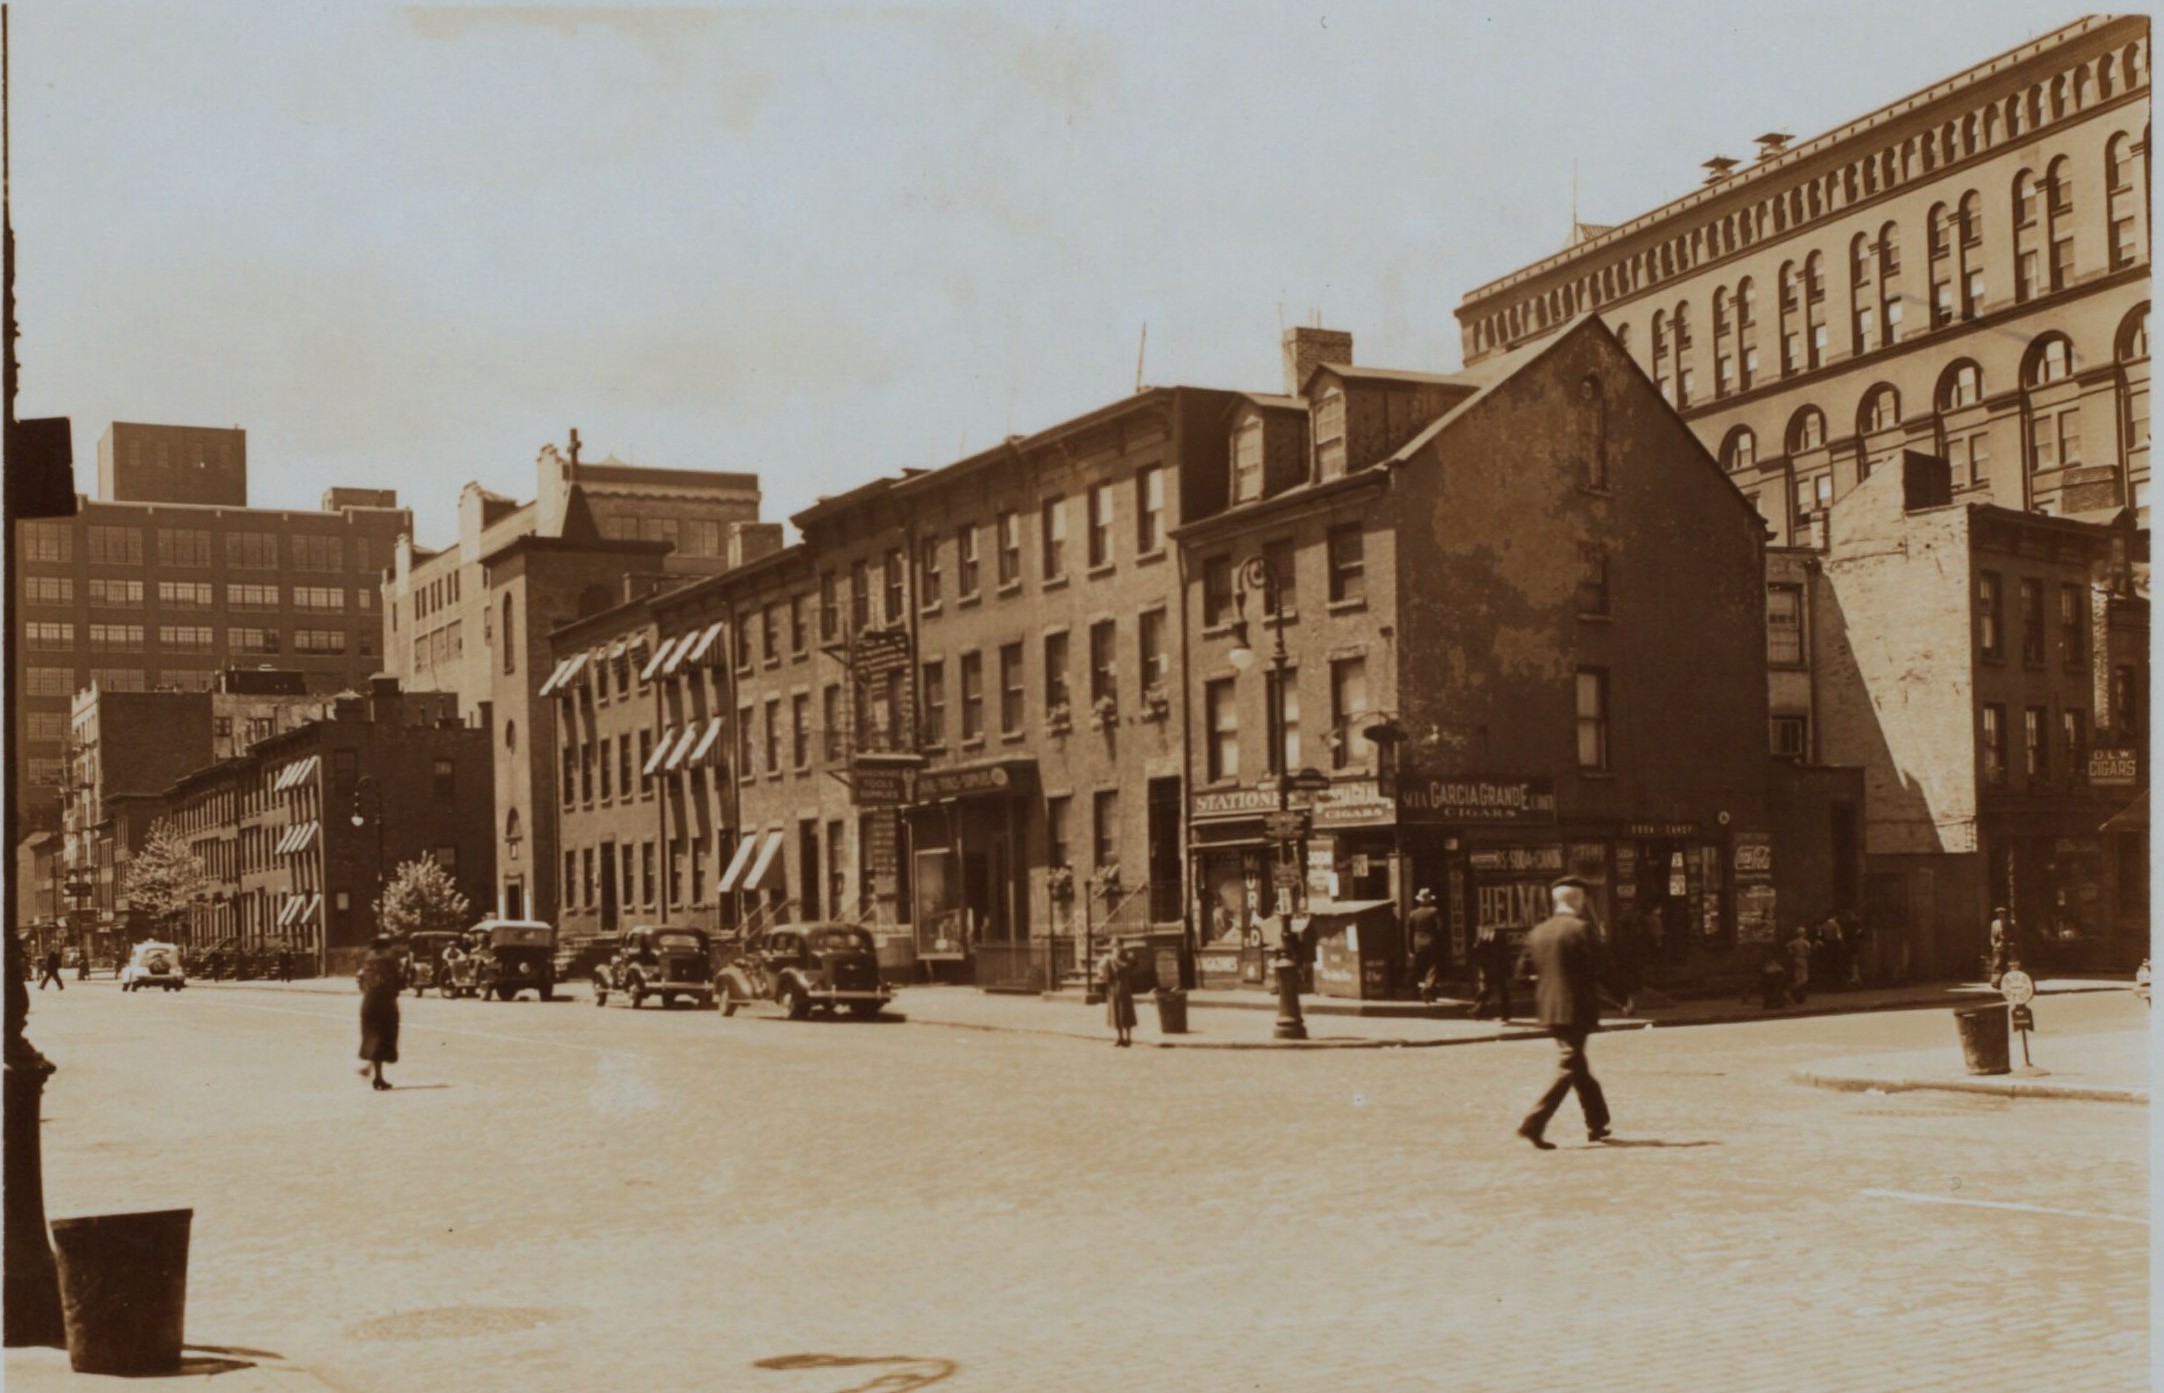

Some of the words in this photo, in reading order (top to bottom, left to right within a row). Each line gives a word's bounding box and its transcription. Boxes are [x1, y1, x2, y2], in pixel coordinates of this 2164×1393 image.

[2088, 760, 2137, 777] CIGARS
[1324, 807, 1383, 819] CIGARS
[1444, 807, 1516, 818] CIGARS
[1244, 854, 1261, 947] MURAD
